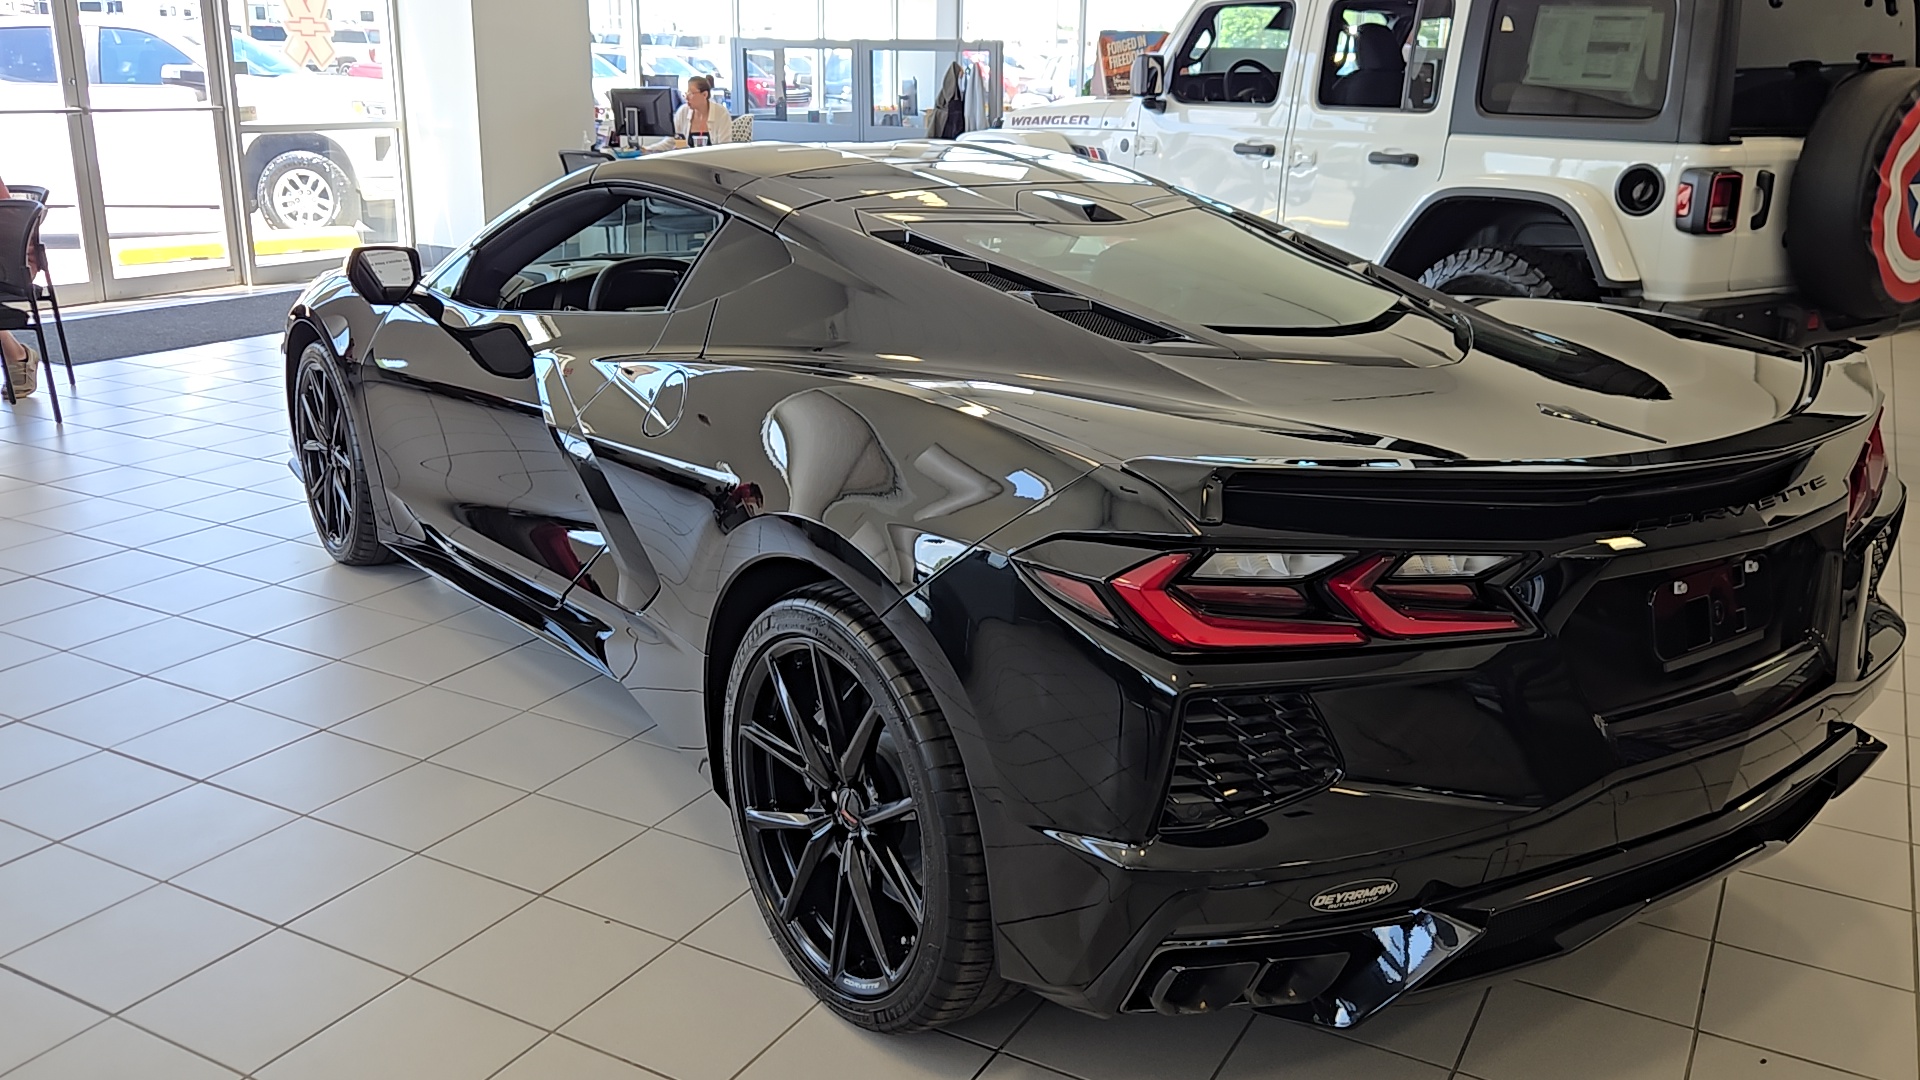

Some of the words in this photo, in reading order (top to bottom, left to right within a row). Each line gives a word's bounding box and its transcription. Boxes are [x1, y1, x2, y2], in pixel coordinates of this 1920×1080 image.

[1106, 37, 1137, 56] FORGED
[1137, 34, 1147, 48] IN
[1011, 115, 1090, 126] WRANGLER
[1631, 475, 1828, 534] CORVETTE
[1313, 882, 1396, 907] DEYARMAN
[1327, 896, 1379, 910] AUTOMOTIVE
[843, 978, 880, 990] CORVETTE
